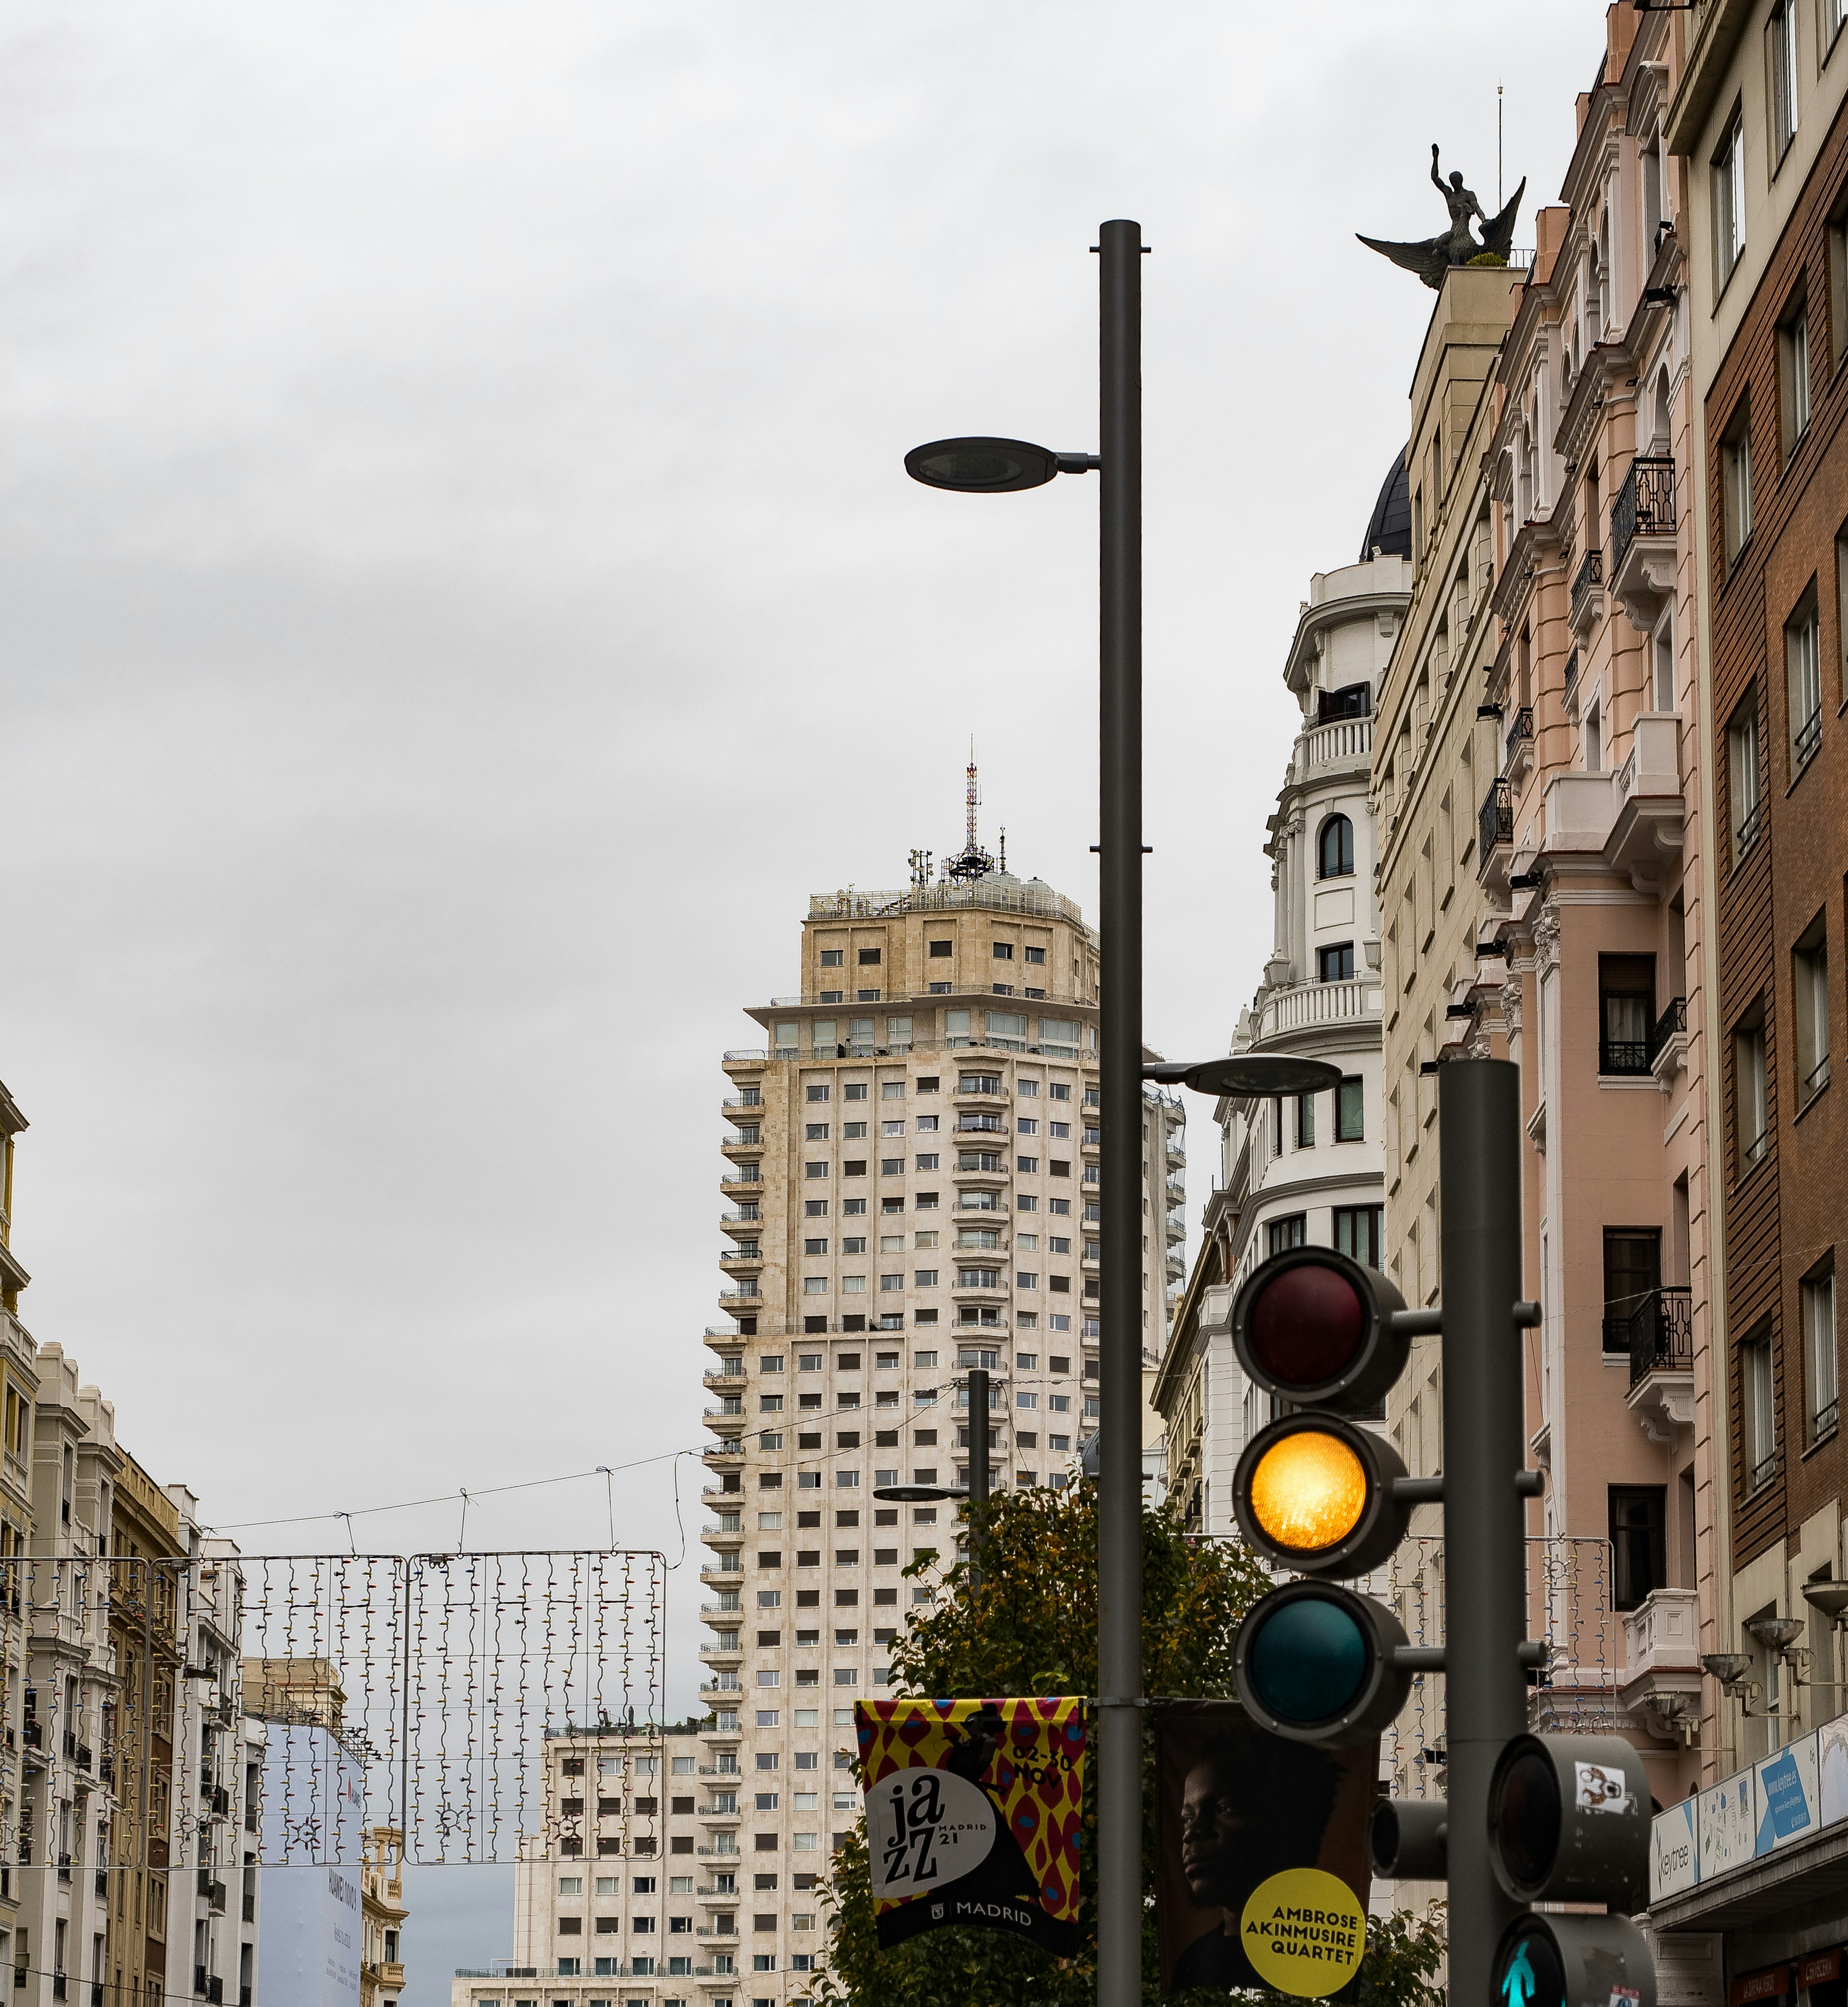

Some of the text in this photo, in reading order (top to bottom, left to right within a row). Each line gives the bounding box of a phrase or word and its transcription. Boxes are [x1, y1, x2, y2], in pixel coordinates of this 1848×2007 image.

[1013, 1746, 1072, 1771] 02-30
[1014, 1762, 1062, 1789] NOV
[1768, 1770, 1796, 1796] www.keytree.es
[939, 1832, 958, 1845] 21
[1660, 1845, 1689, 1881] keytree
[328, 1867, 344, 1903] HUAWEI
[957, 1902, 1031, 1926] MADRID
[1272, 1906, 1358, 1930] AMBROSE
[1245, 1920, 1356, 1948] AKINMUSIRE
[1271, 1940, 1354, 1965] QUARTET
